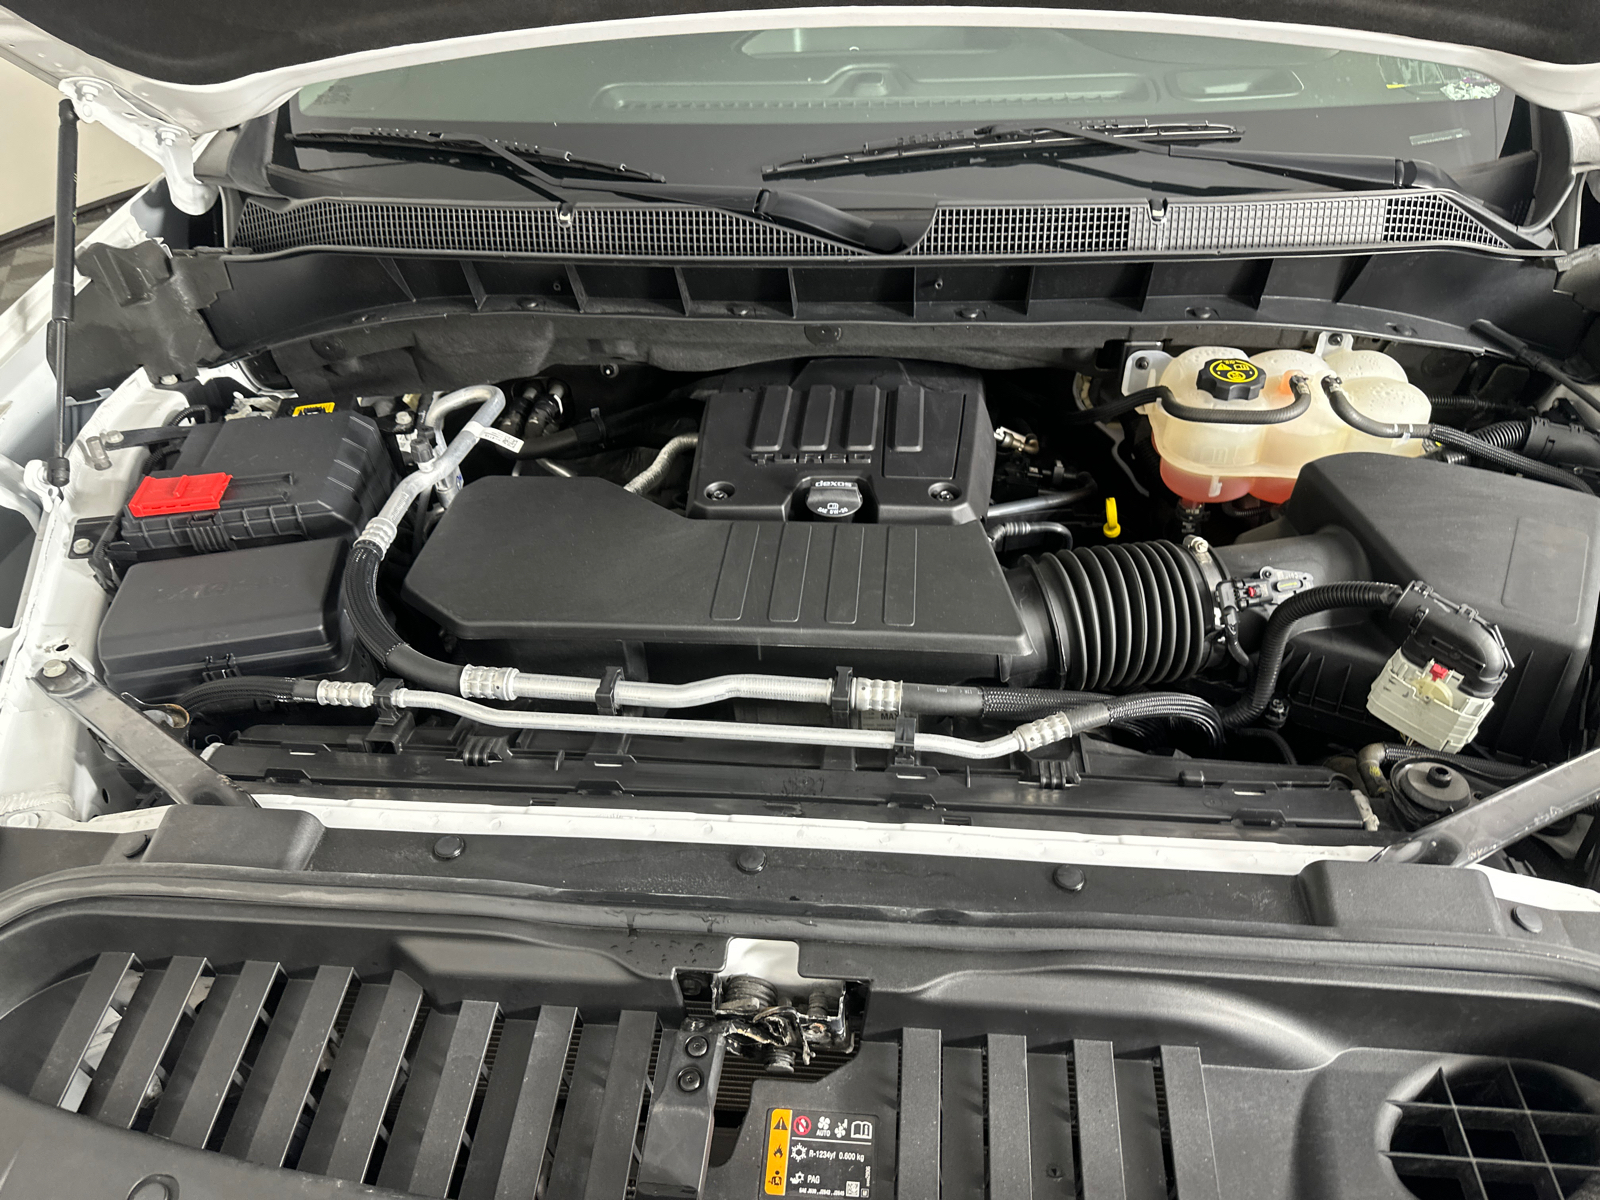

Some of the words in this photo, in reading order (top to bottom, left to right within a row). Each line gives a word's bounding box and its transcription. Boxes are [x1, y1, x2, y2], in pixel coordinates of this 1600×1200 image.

[751, 453, 872, 464] TURBO
[816, 1129, 831, 1137] AUTO
[808, 1149, 837, 1160] R-1234yf
[856, 1153, 865, 1162] kg
[807, 1174, 820, 1184] PAG
